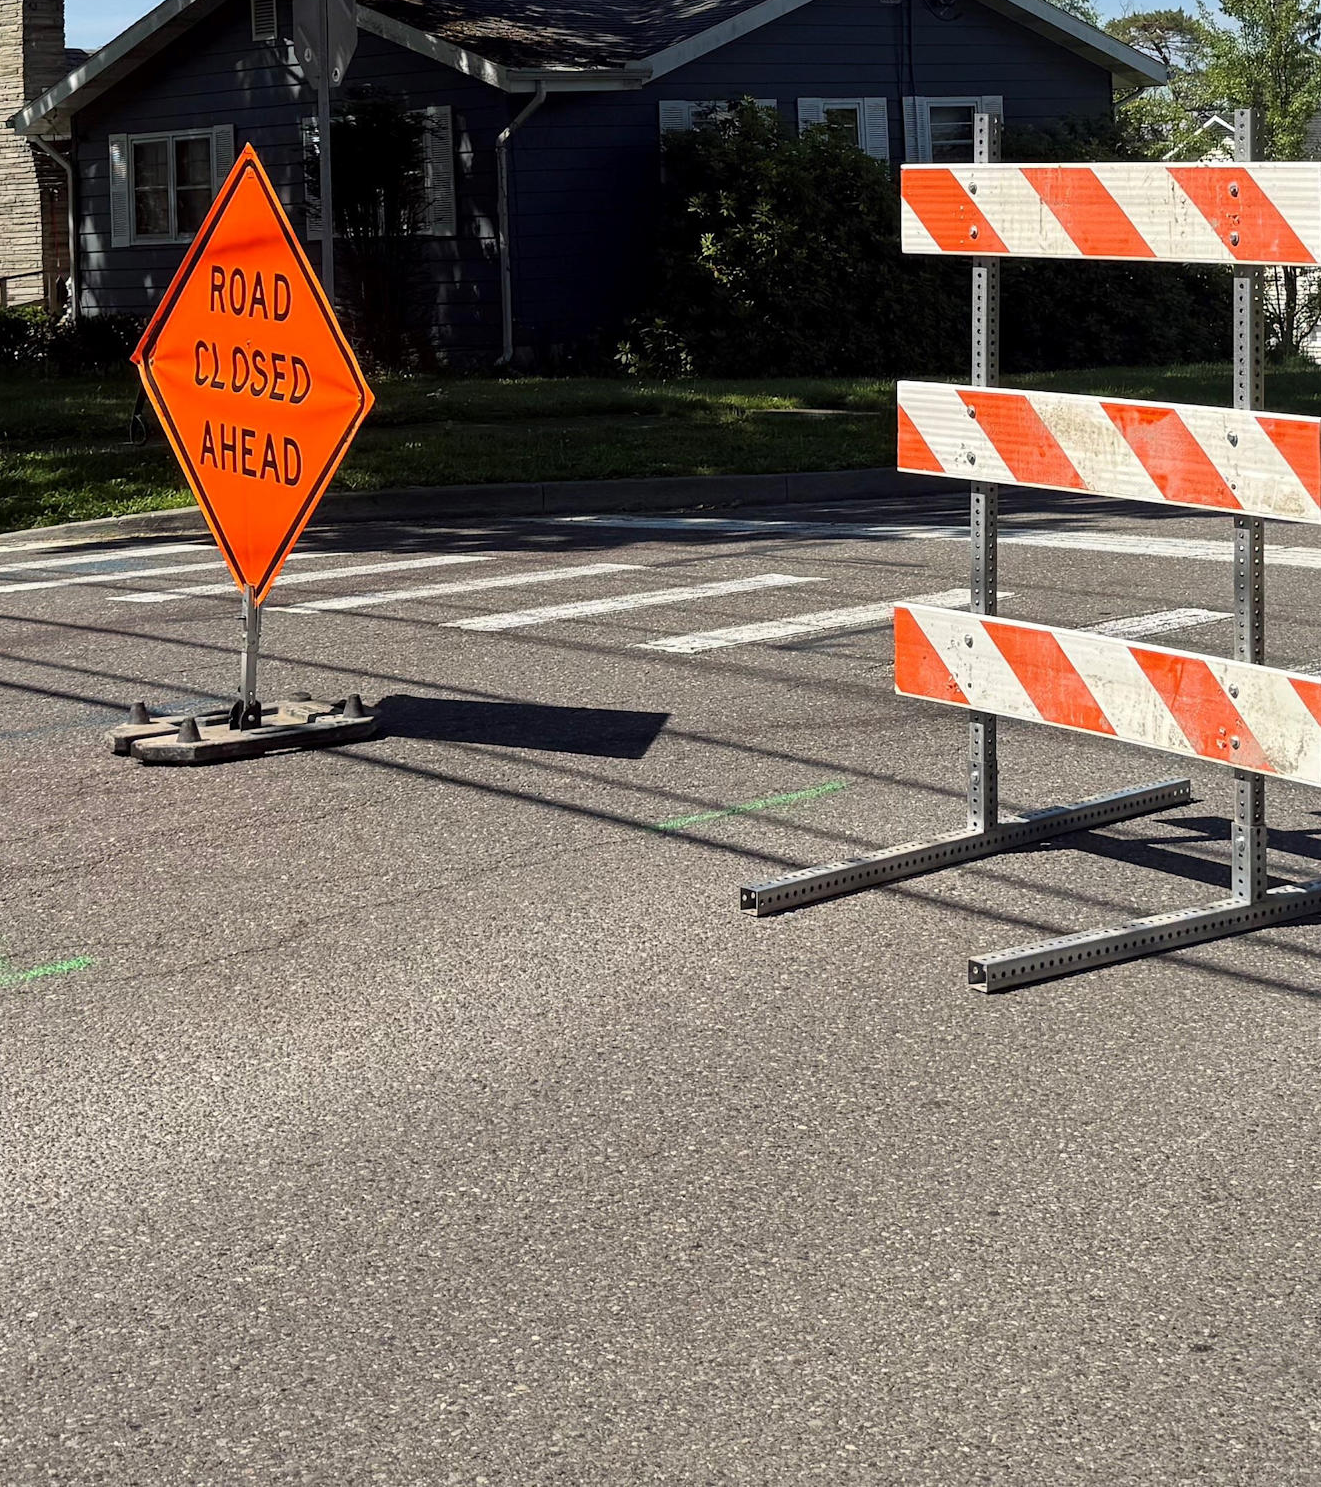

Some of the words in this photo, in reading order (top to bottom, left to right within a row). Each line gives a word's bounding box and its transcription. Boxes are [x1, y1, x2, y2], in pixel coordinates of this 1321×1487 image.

[210, 265, 292, 322] ROAD
[194, 340, 311, 404] CLOSED
[200, 420, 302, 487] AHEAD
